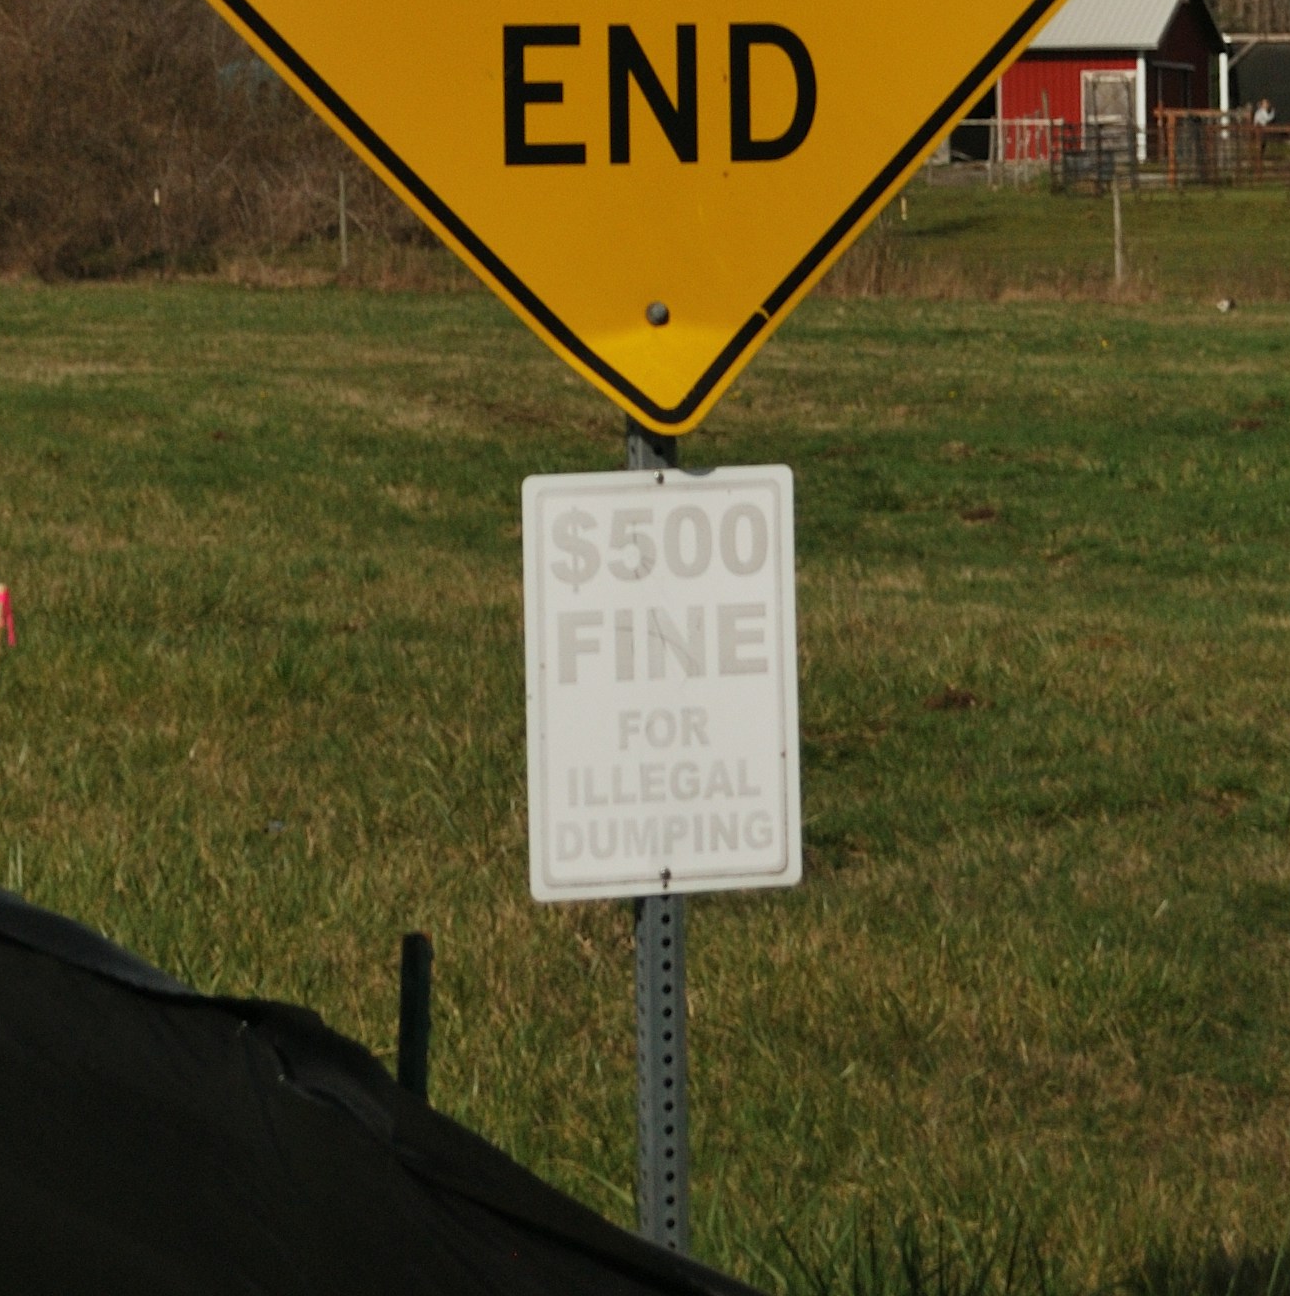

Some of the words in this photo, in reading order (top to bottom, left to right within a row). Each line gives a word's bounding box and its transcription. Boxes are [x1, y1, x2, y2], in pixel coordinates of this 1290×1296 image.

[503, 22, 818, 166] END
[550, 503, 769, 593] $500
[556, 602, 769, 685] FINE
[618, 707, 710, 750] FOR
[567, 757, 761, 808] ILLEGAL
[555, 809, 774, 862] DUMPING
